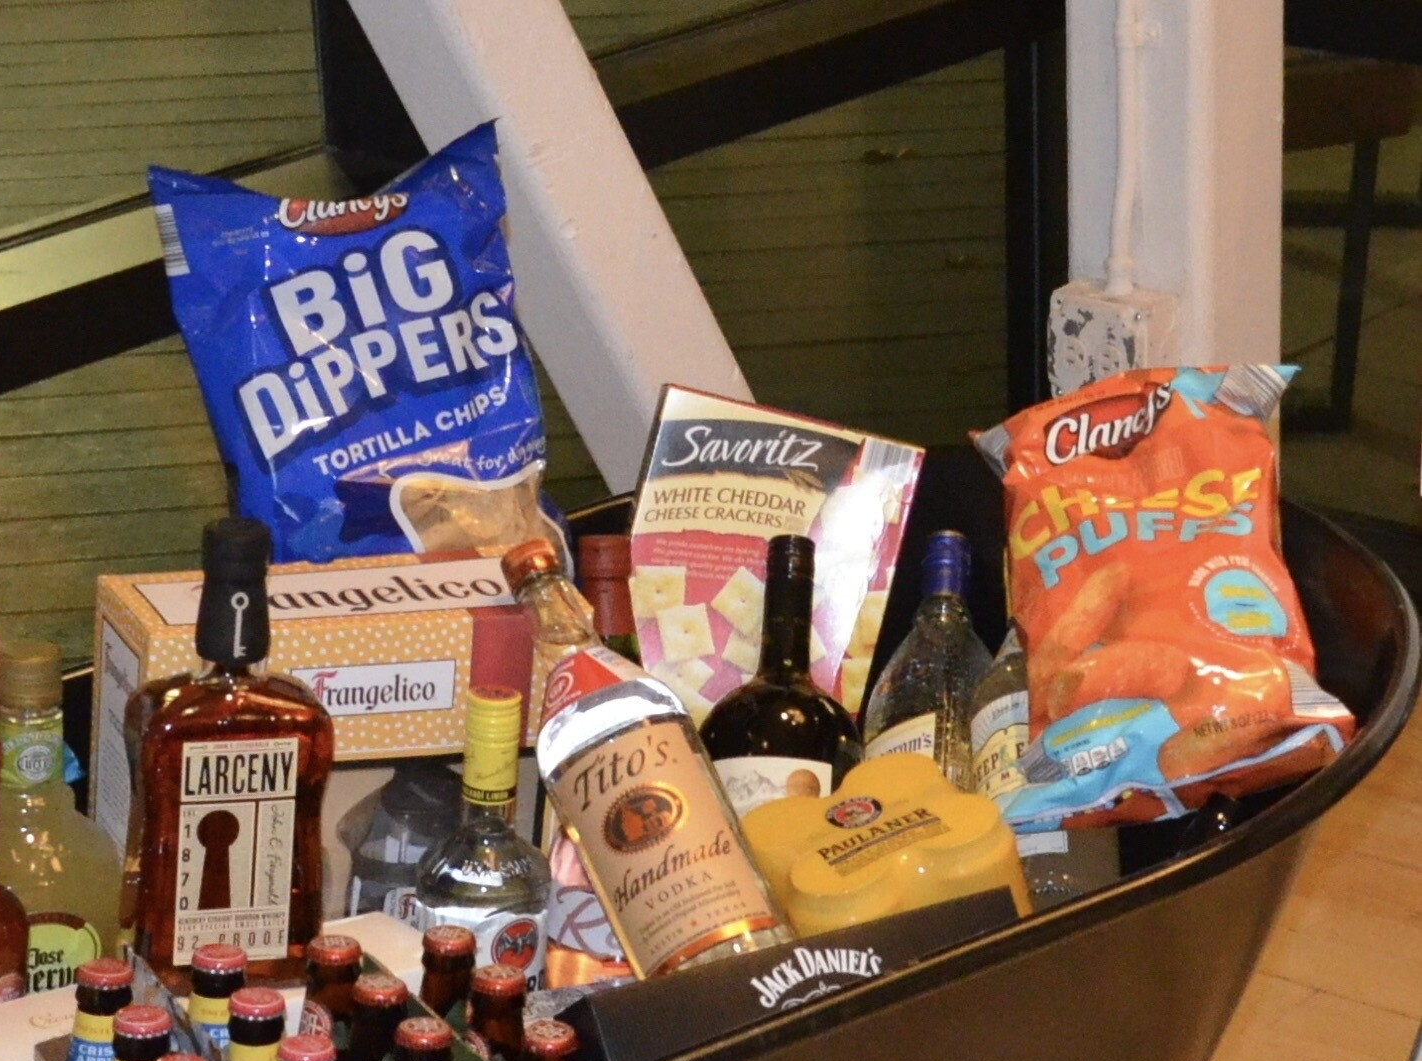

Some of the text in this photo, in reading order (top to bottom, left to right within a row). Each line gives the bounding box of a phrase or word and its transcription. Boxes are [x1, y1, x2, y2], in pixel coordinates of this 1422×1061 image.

[313, 386, 507, 475] TORTILLA CHIPS
[661, 425, 823, 471] Savoritz
[644, 506, 783, 529] CHEESE CRACKERS
[653, 487, 807, 518] WHITE CHEDDAR
[1034, 502, 1254, 589] PUFFS
[268, 574, 502, 612] angelico
[311, 671, 435, 711] Frangelico
[184, 751, 294, 796] LARCENY
[574, 735, 670, 812] Tito's
[817, 808, 932, 860] PAULANER
[614, 830, 731, 912] Handmade
[645, 872, 713, 910] VODKA
[30, 947, 64, 969] Jose
[750, 946, 883, 1008] JACK DANIEL'S
[79, 1044, 114, 1056] CRIS
